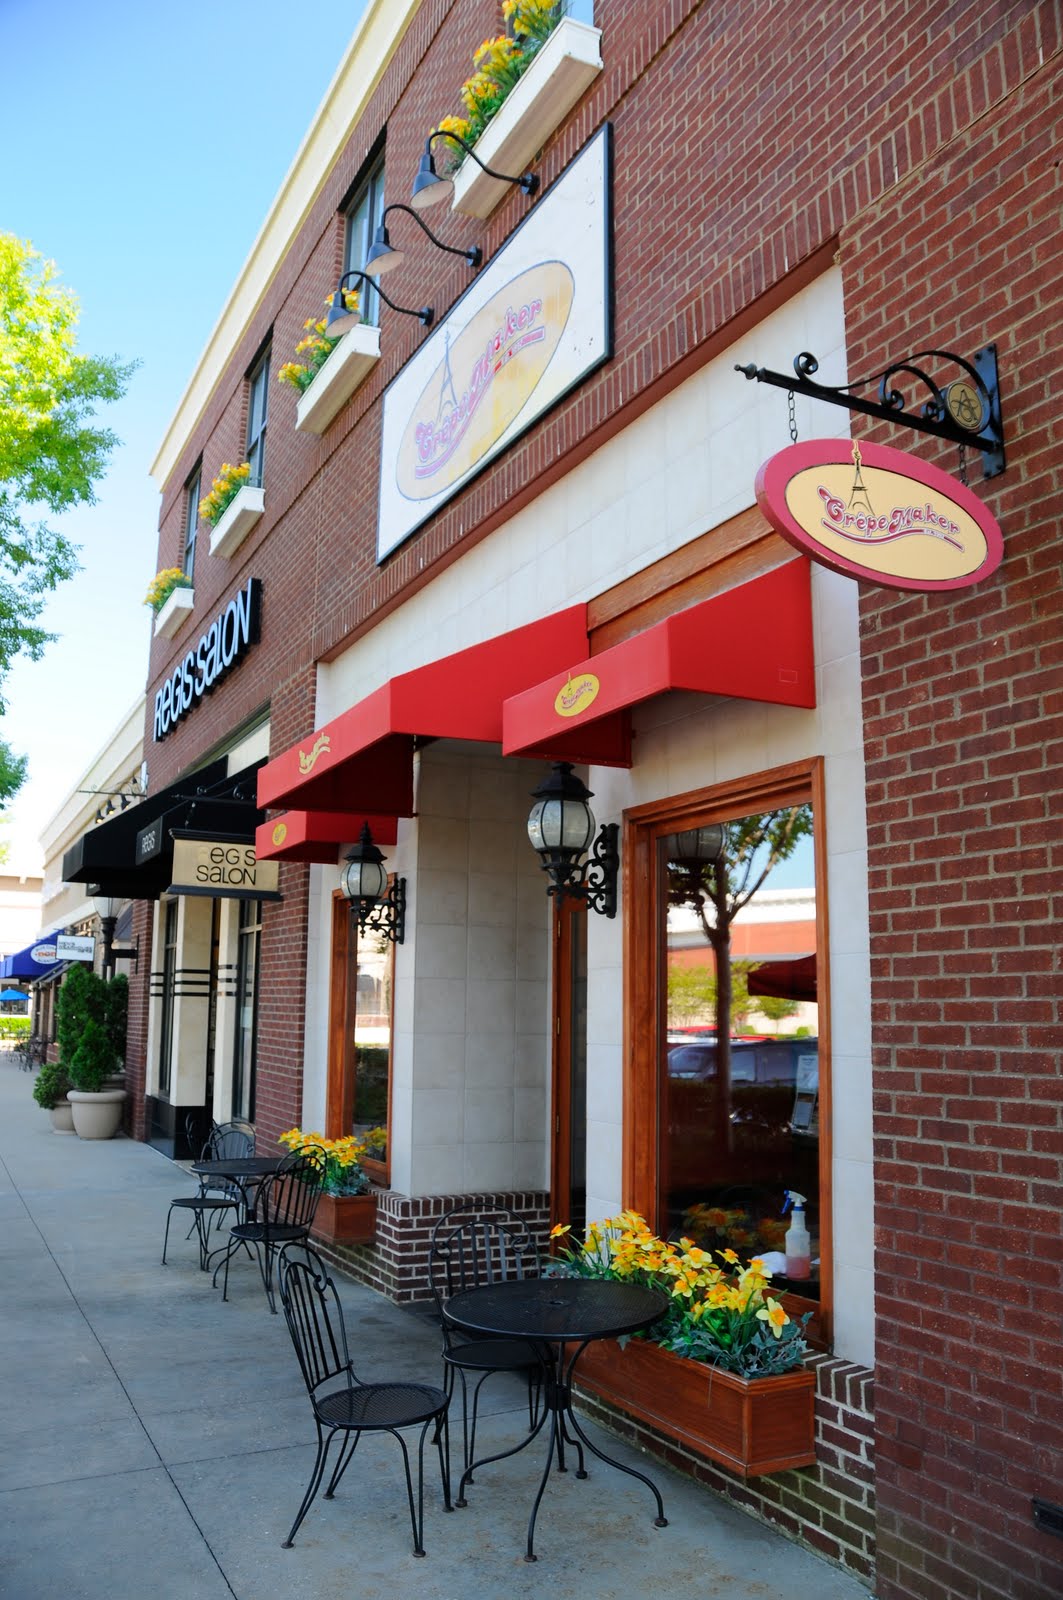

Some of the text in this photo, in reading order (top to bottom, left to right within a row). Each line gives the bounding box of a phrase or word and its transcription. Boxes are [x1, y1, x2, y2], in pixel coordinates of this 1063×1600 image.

[468, 299, 543, 412] Maker
[817, 485, 960, 537] Crêpe Maker
